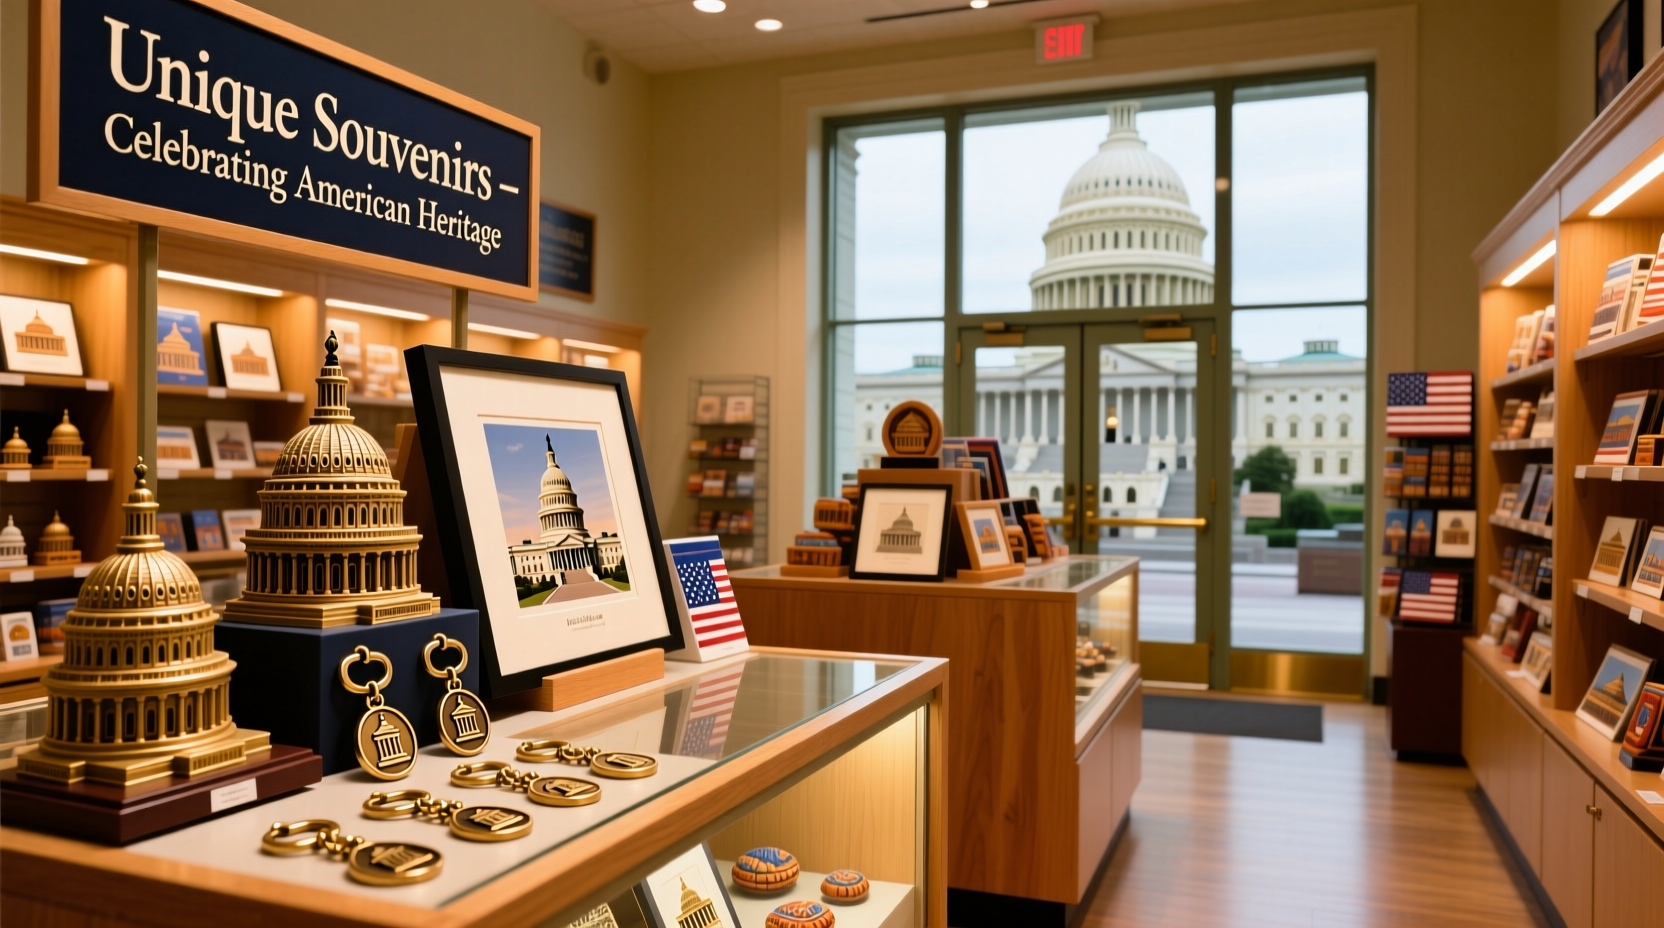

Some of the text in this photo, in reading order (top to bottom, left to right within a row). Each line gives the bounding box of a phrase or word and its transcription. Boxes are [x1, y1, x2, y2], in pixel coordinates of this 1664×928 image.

[104, 16, 299, 143] Unique
[313, 92, 493, 201] Souvenirs
[104, 113, 288, 204] Celebrating
[294, 166, 411, 226] American
[417, 197, 502, 256] Heritage
